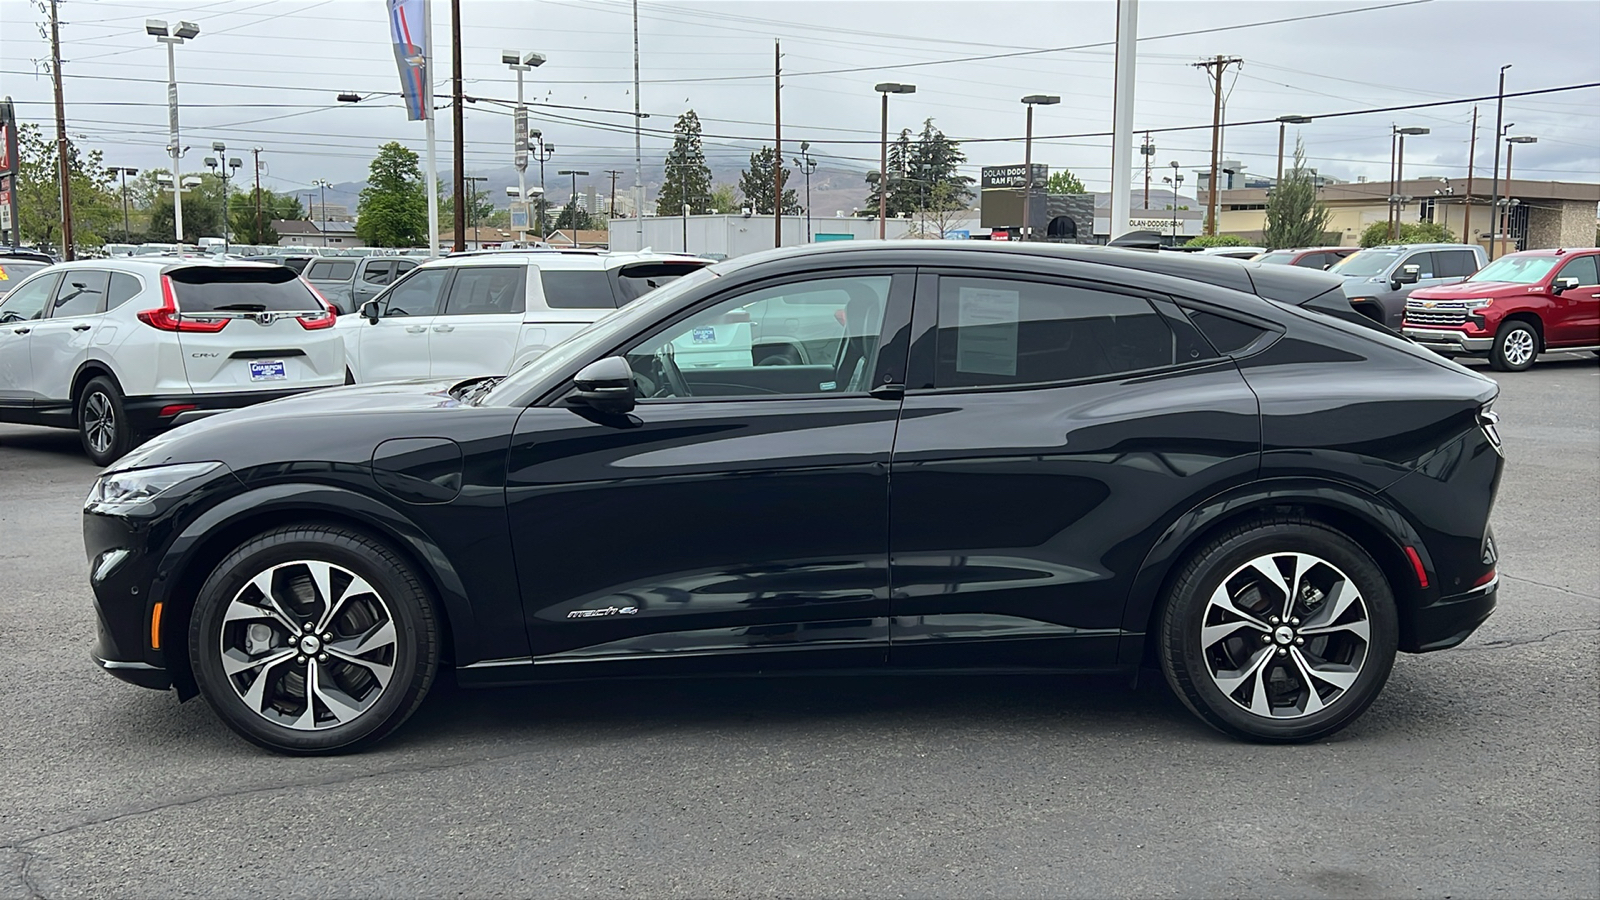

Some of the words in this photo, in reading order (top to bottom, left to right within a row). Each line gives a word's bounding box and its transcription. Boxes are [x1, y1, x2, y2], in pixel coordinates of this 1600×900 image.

[983, 170, 1006, 178] DOLAN
[1007, 168, 1026, 176] DODG
[991, 177, 1006, 185] RAM
